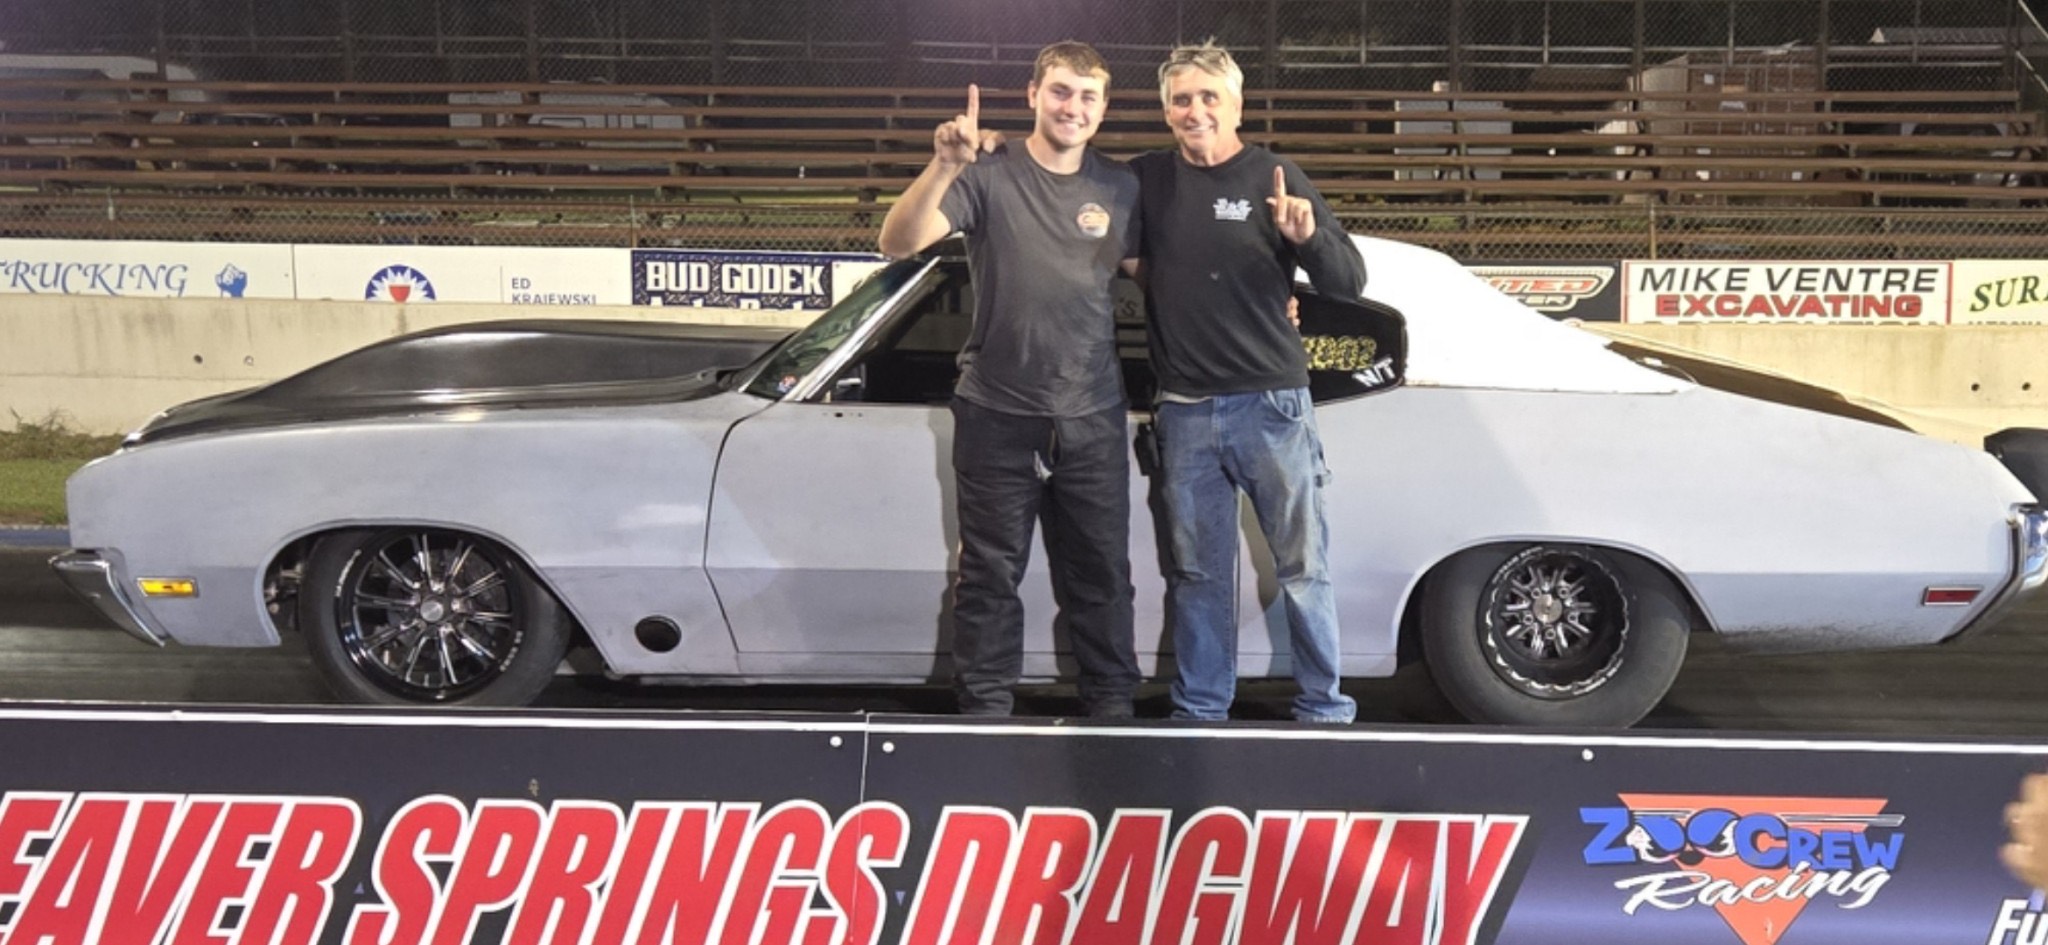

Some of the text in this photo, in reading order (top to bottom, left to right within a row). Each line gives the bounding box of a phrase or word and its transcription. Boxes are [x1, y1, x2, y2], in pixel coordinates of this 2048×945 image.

[0, 260, 188, 297] RUCKING
[511, 277, 531, 290] ED
[646, 261, 825, 295] BUD GODEK
[1639, 267, 1939, 293] MIKE VENTRE
[1969, 275, 2048, 312] SUR
[1655, 294, 1923, 317] EXCAVATING
[341, 794, 910, 945] SPRINGS
[900, 805, 1529, 945] DRAGWAY
[1614, 860, 1892, 916] Racing
